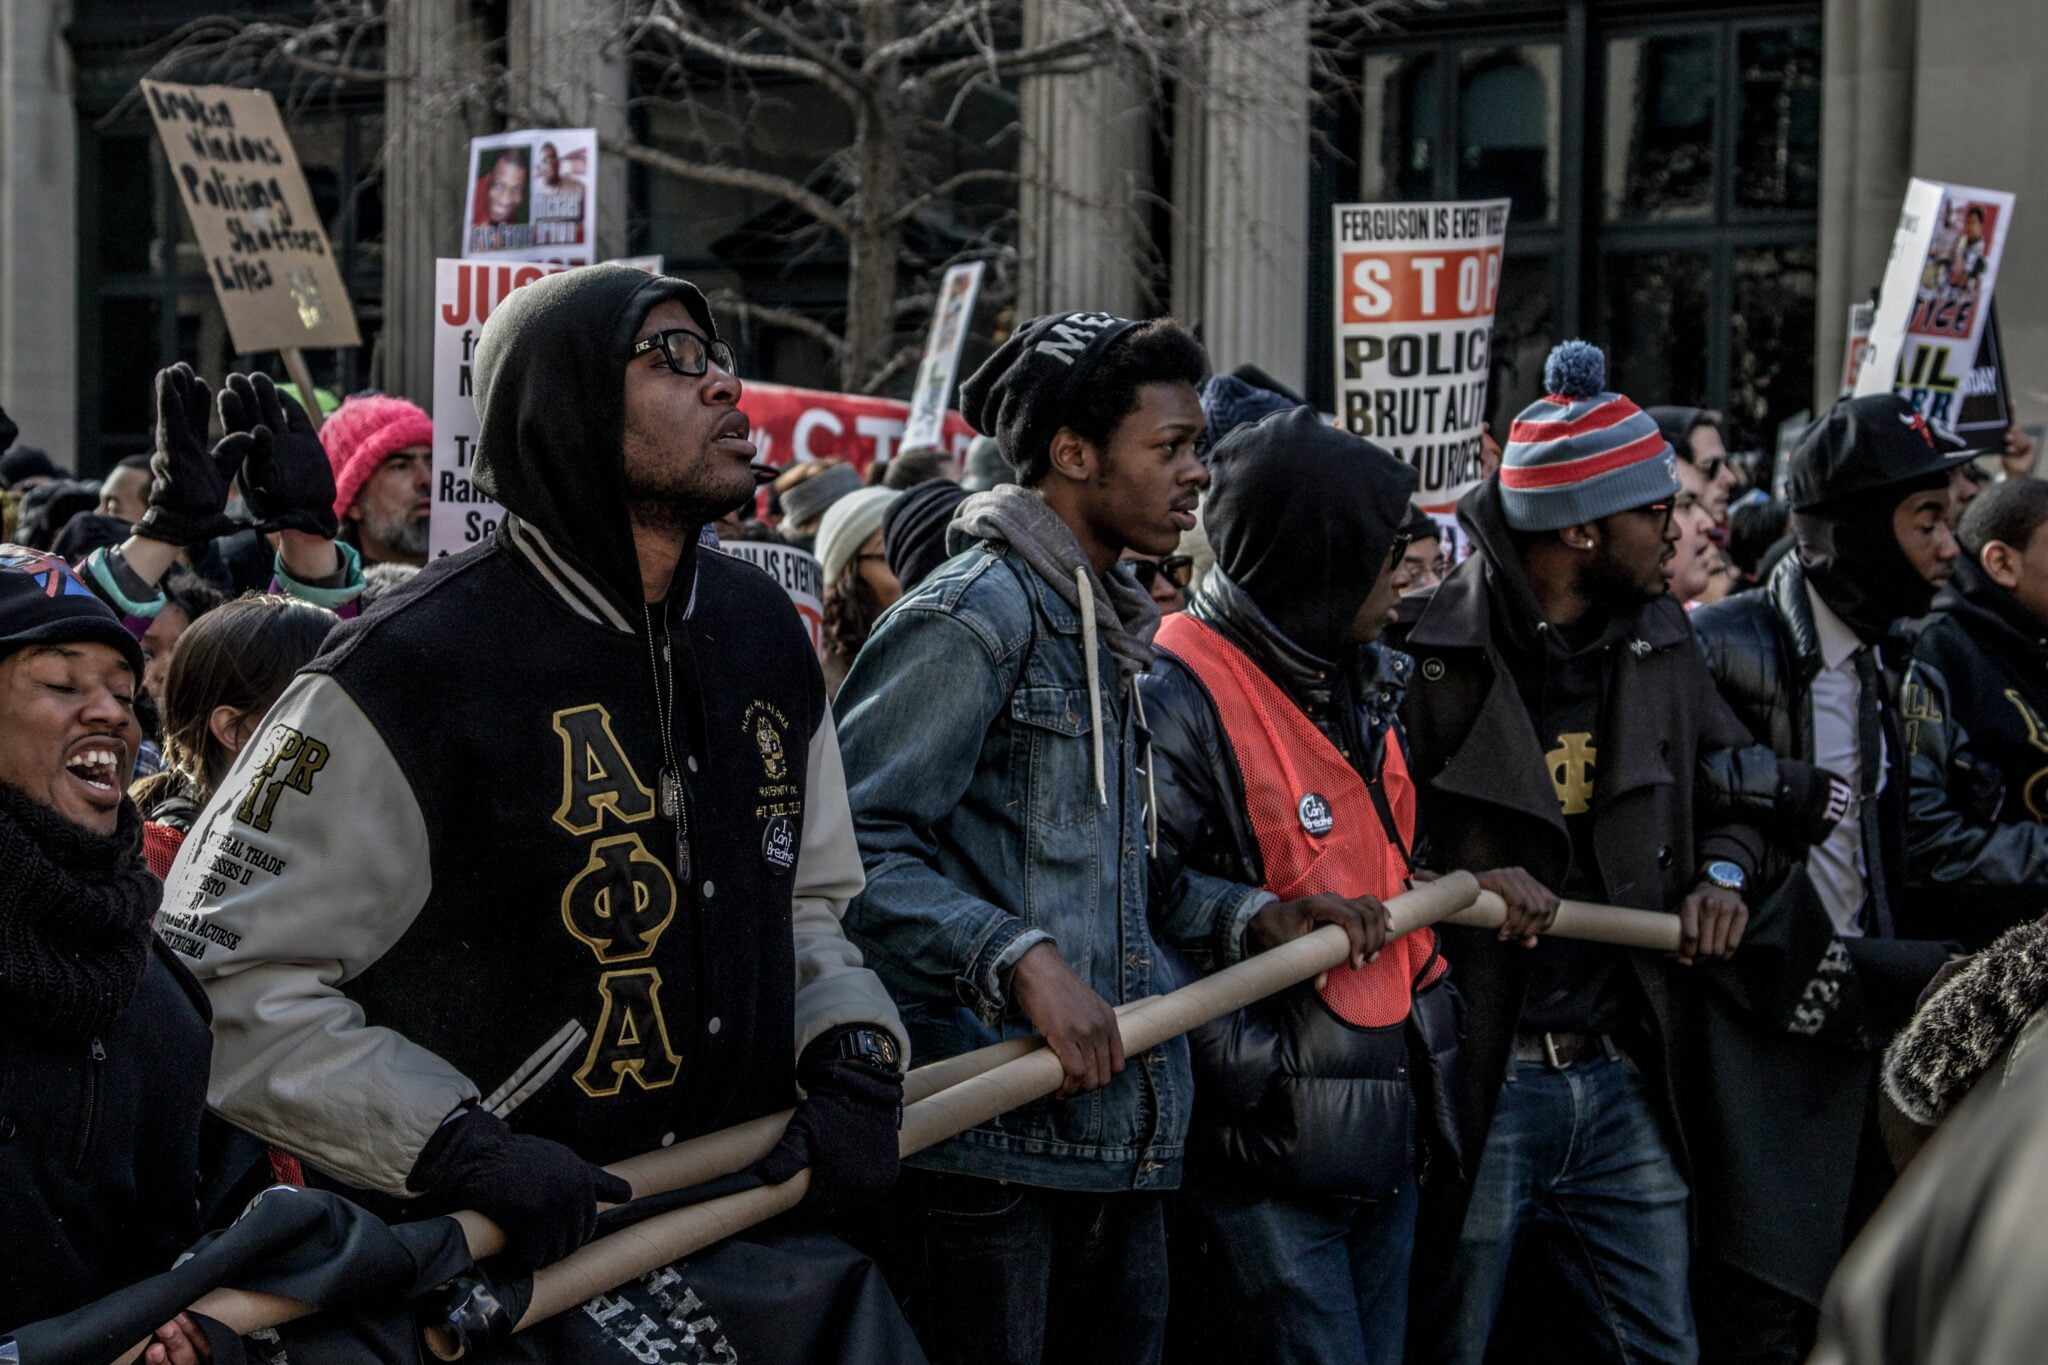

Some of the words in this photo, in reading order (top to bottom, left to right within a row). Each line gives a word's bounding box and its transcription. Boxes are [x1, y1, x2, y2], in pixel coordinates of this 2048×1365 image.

[1341, 207, 1430, 242] FERGUSON
[1434, 207, 1449, 239] IS
[212, 255, 273, 292] Lives
[1352, 253, 1500, 318] STOP
[1344, 380, 1488, 438] BRUTALIT
[773, 826, 793, 848] Can't
[782, 819, 788, 834] I
[766, 840, 794, 864] Breathe
